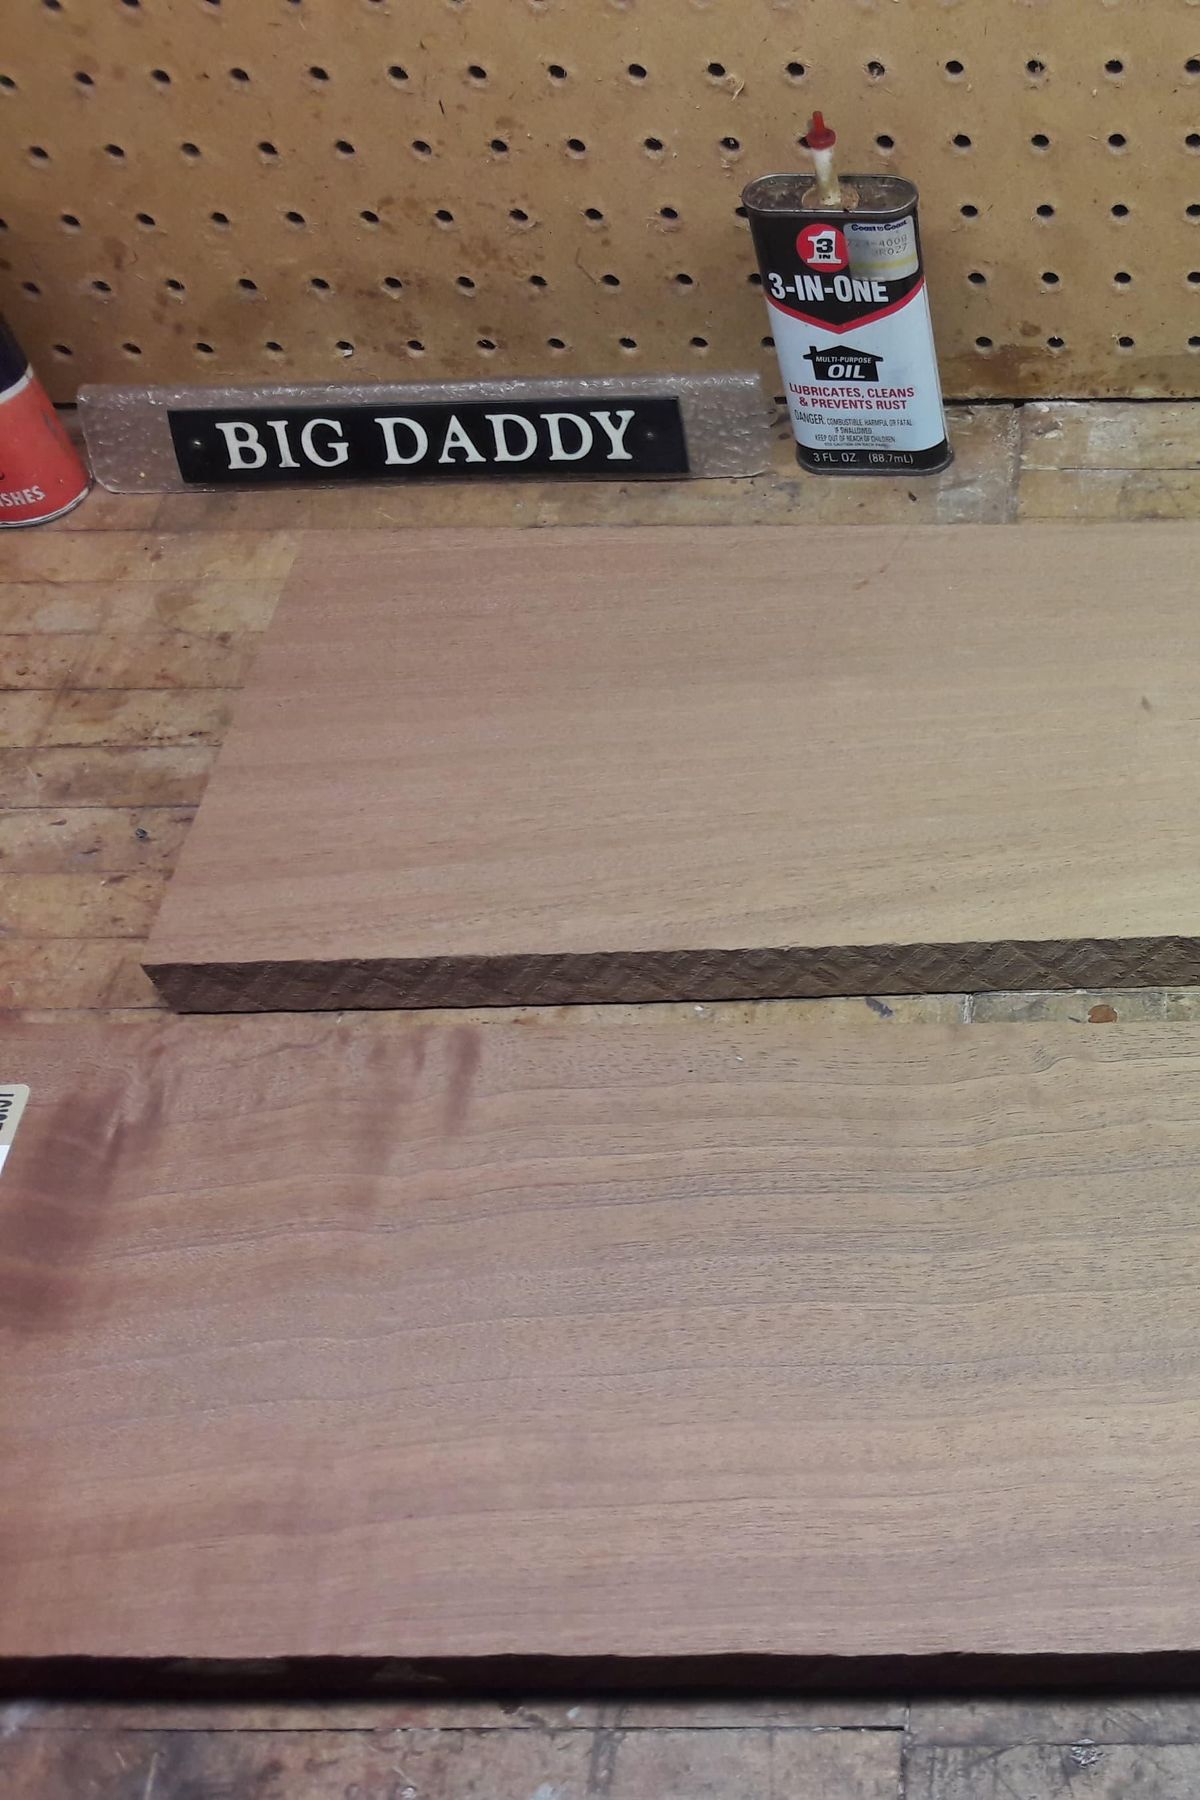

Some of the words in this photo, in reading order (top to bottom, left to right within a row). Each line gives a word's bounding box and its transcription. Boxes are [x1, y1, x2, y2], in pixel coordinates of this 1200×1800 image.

[851, 223, 876, 232] Coast
[884, 219, 907, 231] Coast
[816, 238, 833, 254] 3
[768, 272, 889, 303] 3-IN-ONE
[815, 356, 872, 364] MULTI-PURPOSE
[827, 364, 866, 379] OIL
[789, 382, 865, 399] LUBRICATES,
[867, 387, 914, 398] CLEANS
[799, 396, 808, 407] &
[811, 398, 873, 410] PREVENTS
[876, 400, 907, 410] RUST
[215, 418, 349, 470] BIG
[374, 410, 636, 466] DADDY
[813, 452, 820, 462] 3
[868, 453, 914, 465] (88.7mL)
